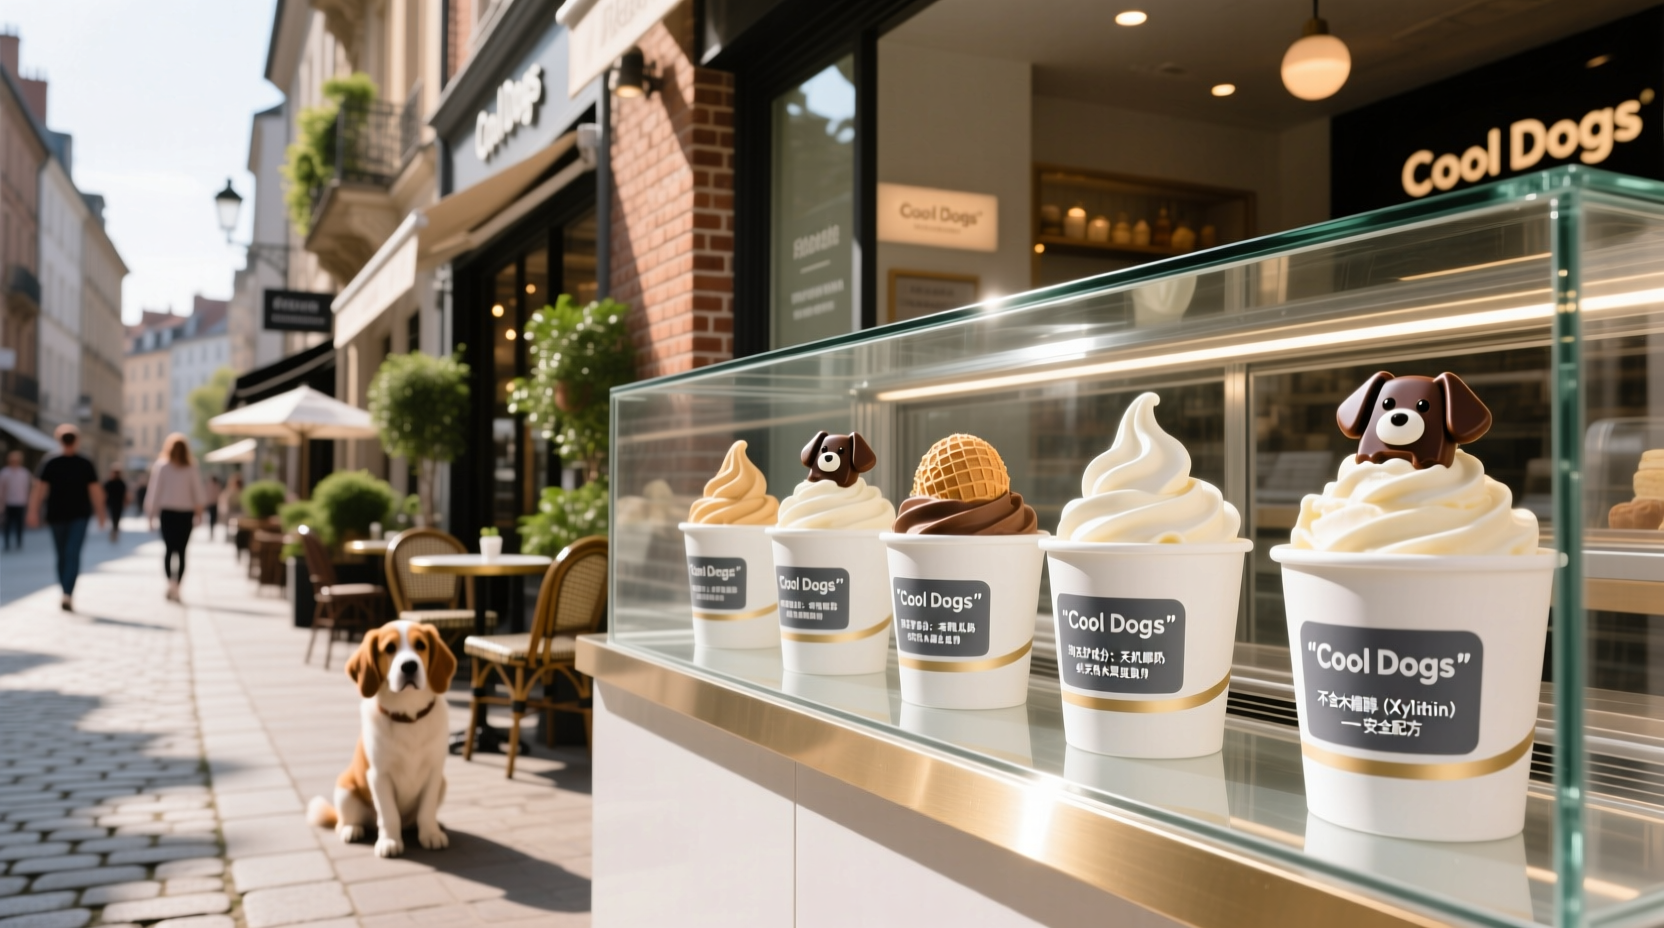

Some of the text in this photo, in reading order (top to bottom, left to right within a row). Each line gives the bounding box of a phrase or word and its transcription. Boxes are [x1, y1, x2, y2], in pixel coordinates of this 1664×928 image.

[1401, 99, 1643, 198] Cool Dogs
[899, 202, 937, 221] Cool
